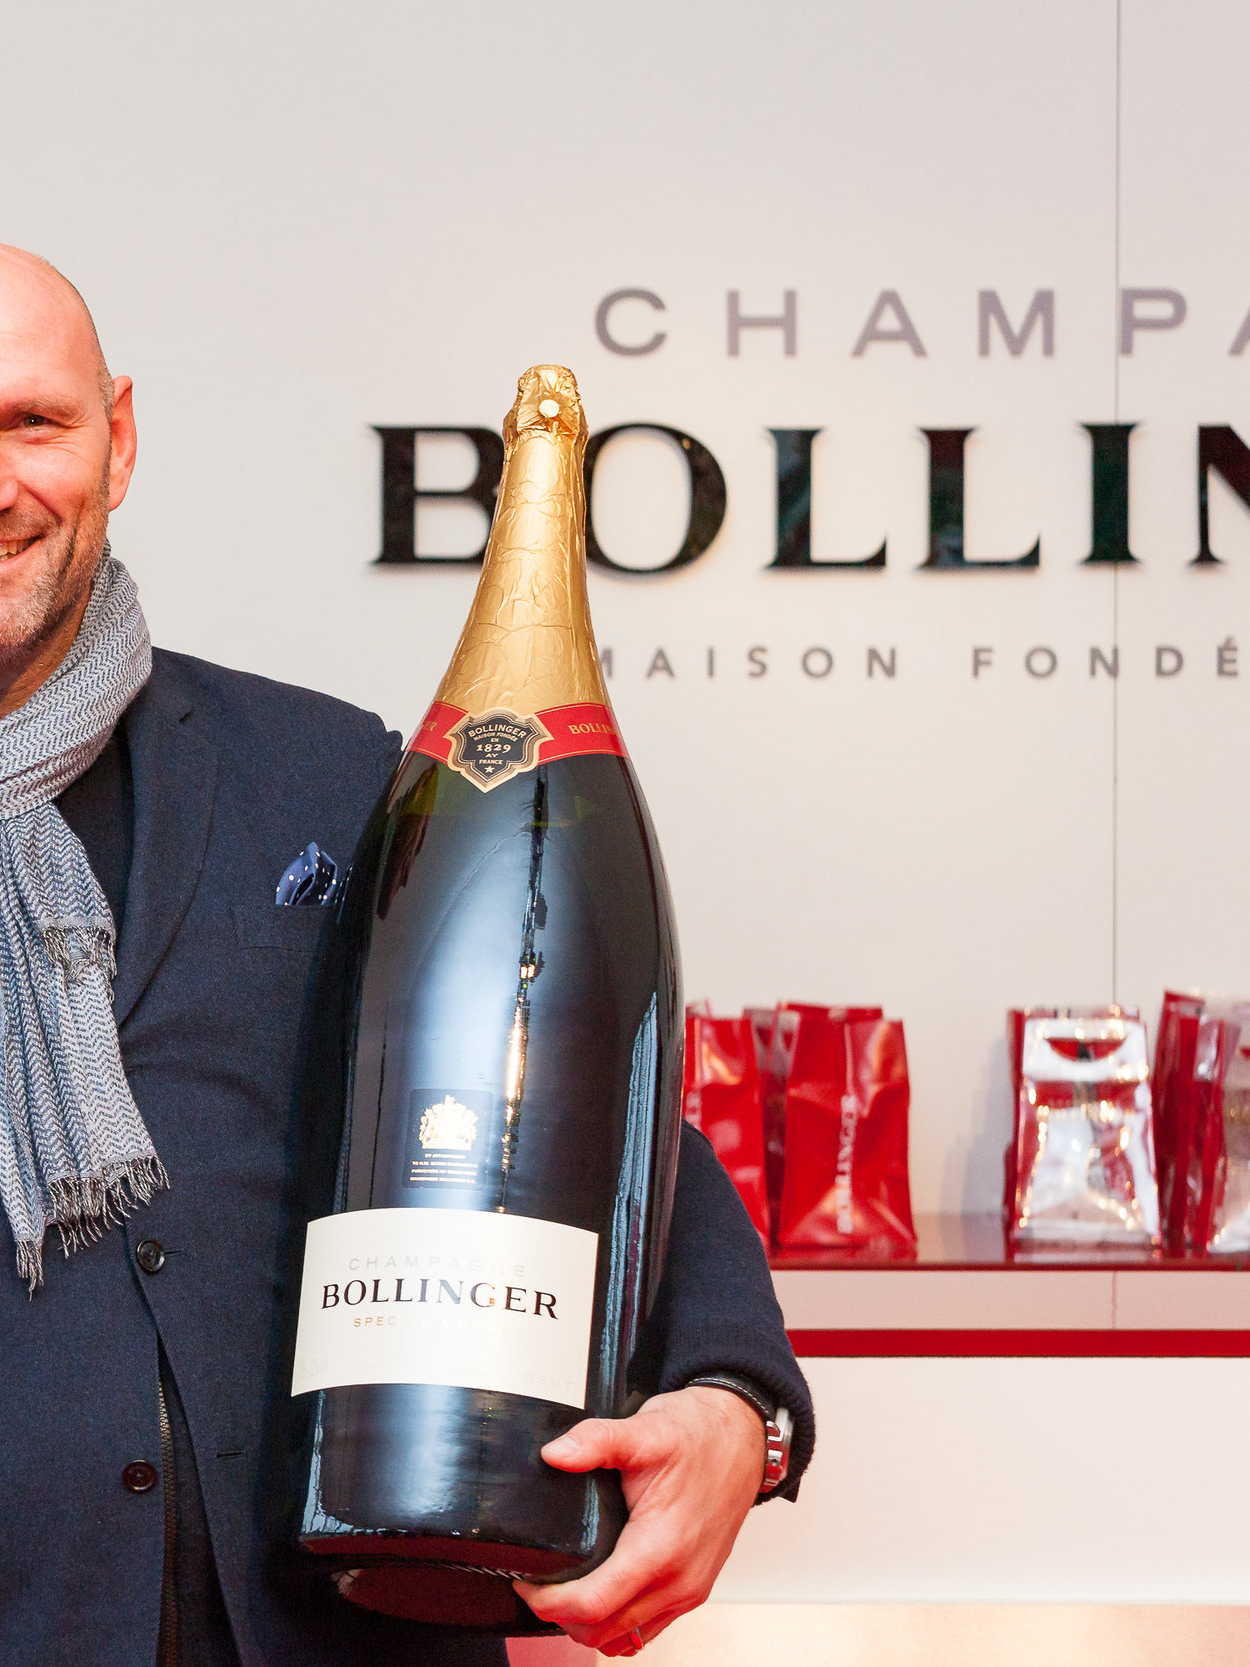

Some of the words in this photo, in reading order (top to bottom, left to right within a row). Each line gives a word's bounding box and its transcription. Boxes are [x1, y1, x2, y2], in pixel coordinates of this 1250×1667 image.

[594, 287, 1250, 358] CHAMP
[972, 636, 1239, 679] FONDÉ
[468, 724, 527, 738] BOLLINGER
[476, 743, 511, 754] 1829
[348, 1255, 527, 1278] CHAMPAGNE
[321, 1278, 558, 1320] BOLLINGER
